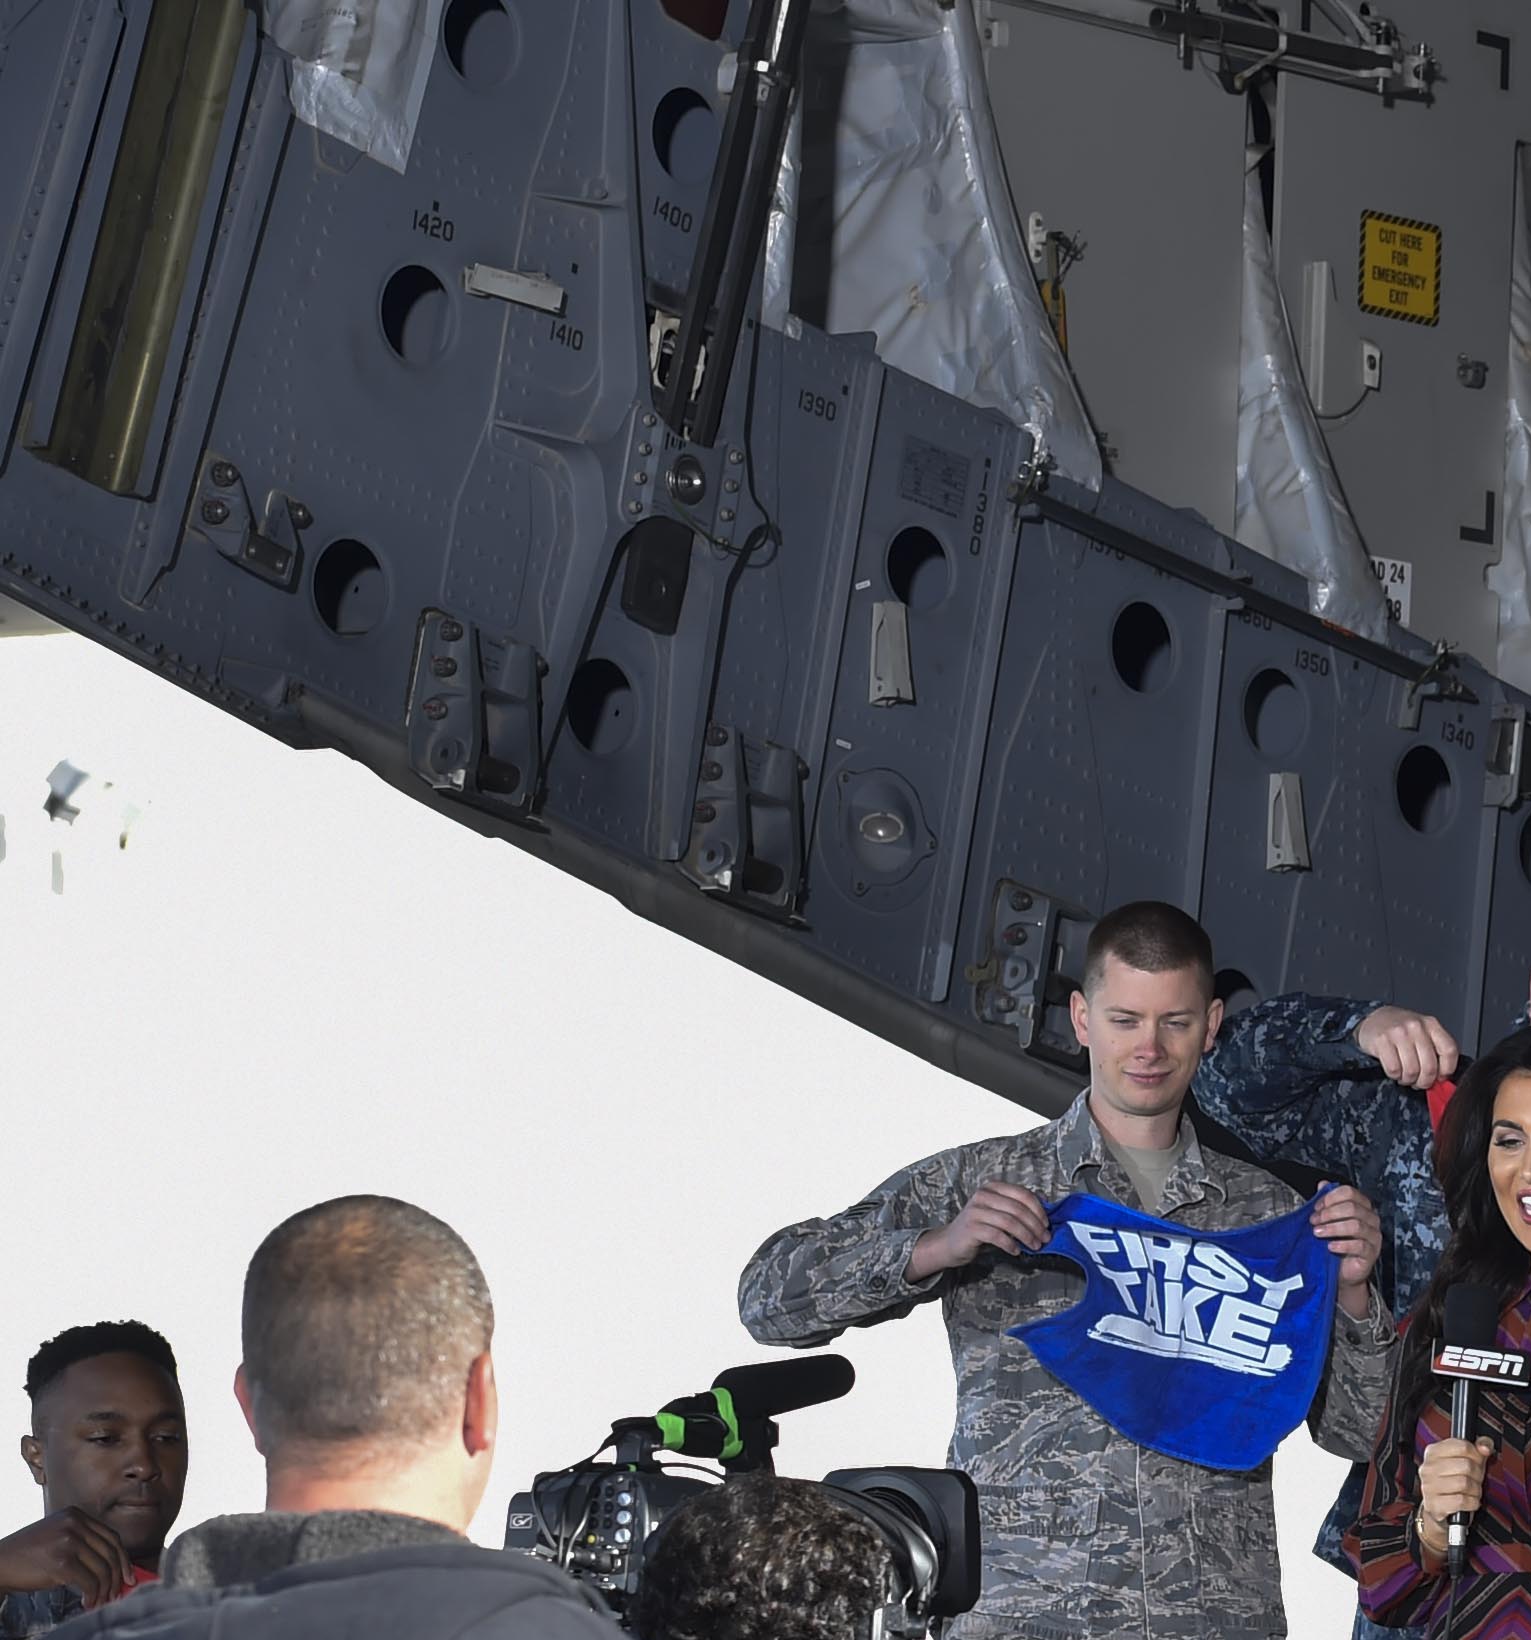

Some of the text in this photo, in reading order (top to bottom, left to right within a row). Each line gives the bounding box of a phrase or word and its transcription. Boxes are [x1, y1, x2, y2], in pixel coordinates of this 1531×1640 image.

[413, 209, 455, 243] 1420
[653, 196, 692, 233] 1400
[1379, 228, 1422, 252] CUT HERE
[1392, 250, 1408, 267] FOR
[1372, 265, 1426, 291] EMERGENCY
[1389, 289, 1408, 306] EXIT
[550, 321, 583, 352] 1410
[798, 389, 837, 422] 1390
[970, 475, 988, 557] 1380
[1390, 563, 1405, 584] 24
[1295, 649, 1329, 676] 1350
[1441, 721, 1475, 751] 1340
[1066, 1220, 1304, 1310] FIRST
[1097, 1263, 1280, 1361] TAKE
[1440, 1344, 1525, 1377] ESPN
